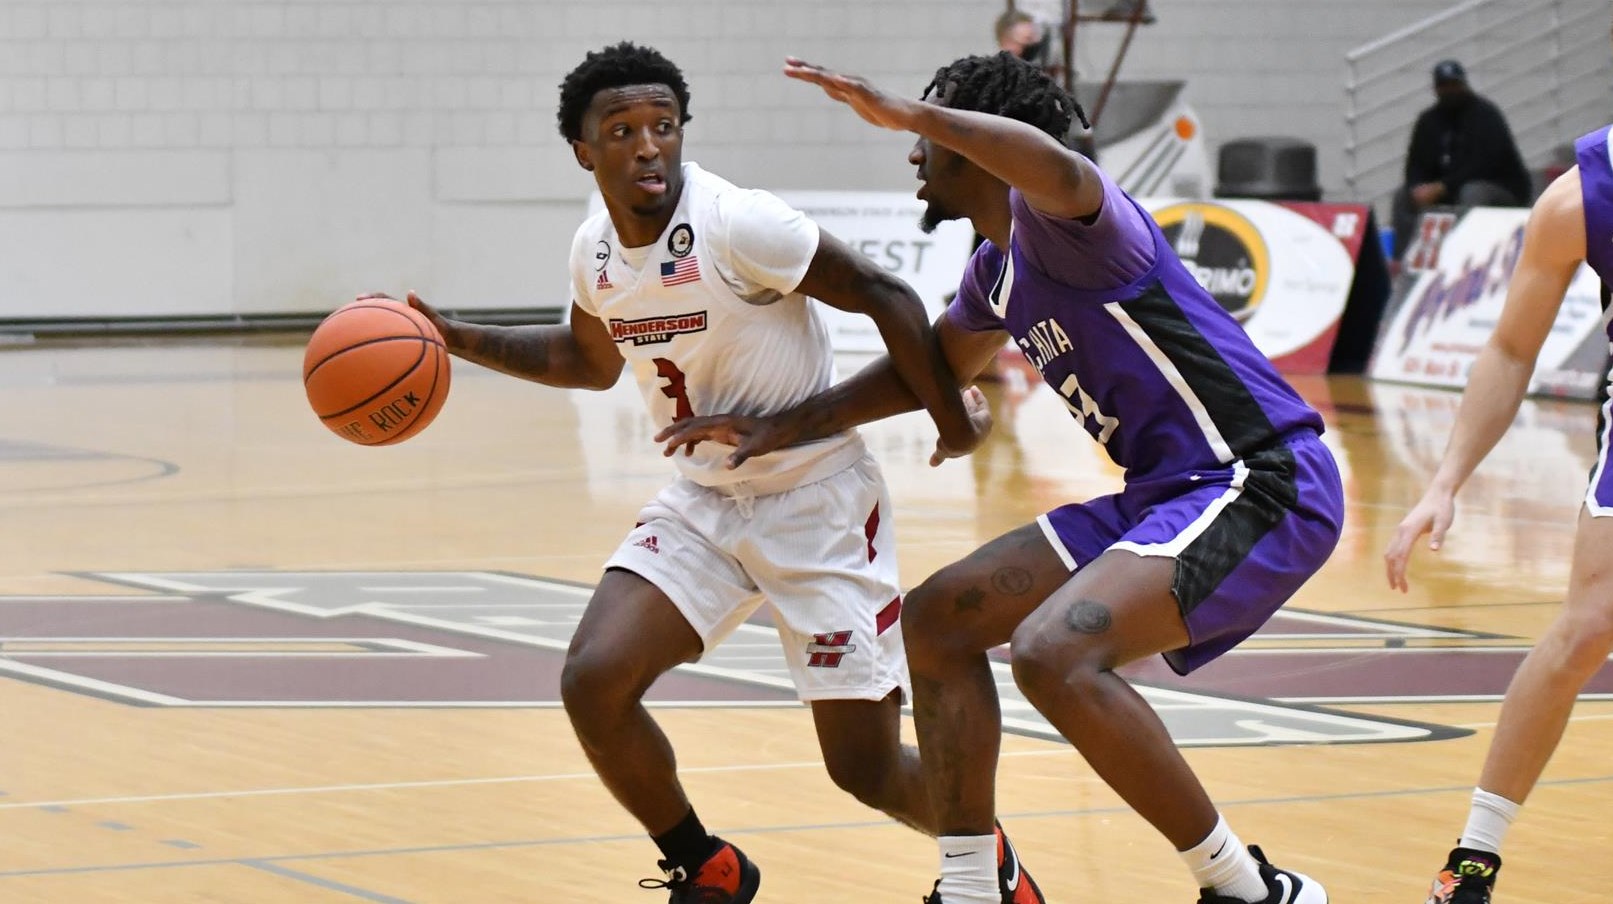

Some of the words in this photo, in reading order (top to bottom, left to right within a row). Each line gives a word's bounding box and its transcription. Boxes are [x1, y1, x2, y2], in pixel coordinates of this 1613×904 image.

[849, 239, 934, 274] EST
[610, 315, 705, 338] HENDERSON
[636, 333, 669, 344] STATE
[651, 357, 696, 423] 3
[368, 391, 420, 432] ROCK
